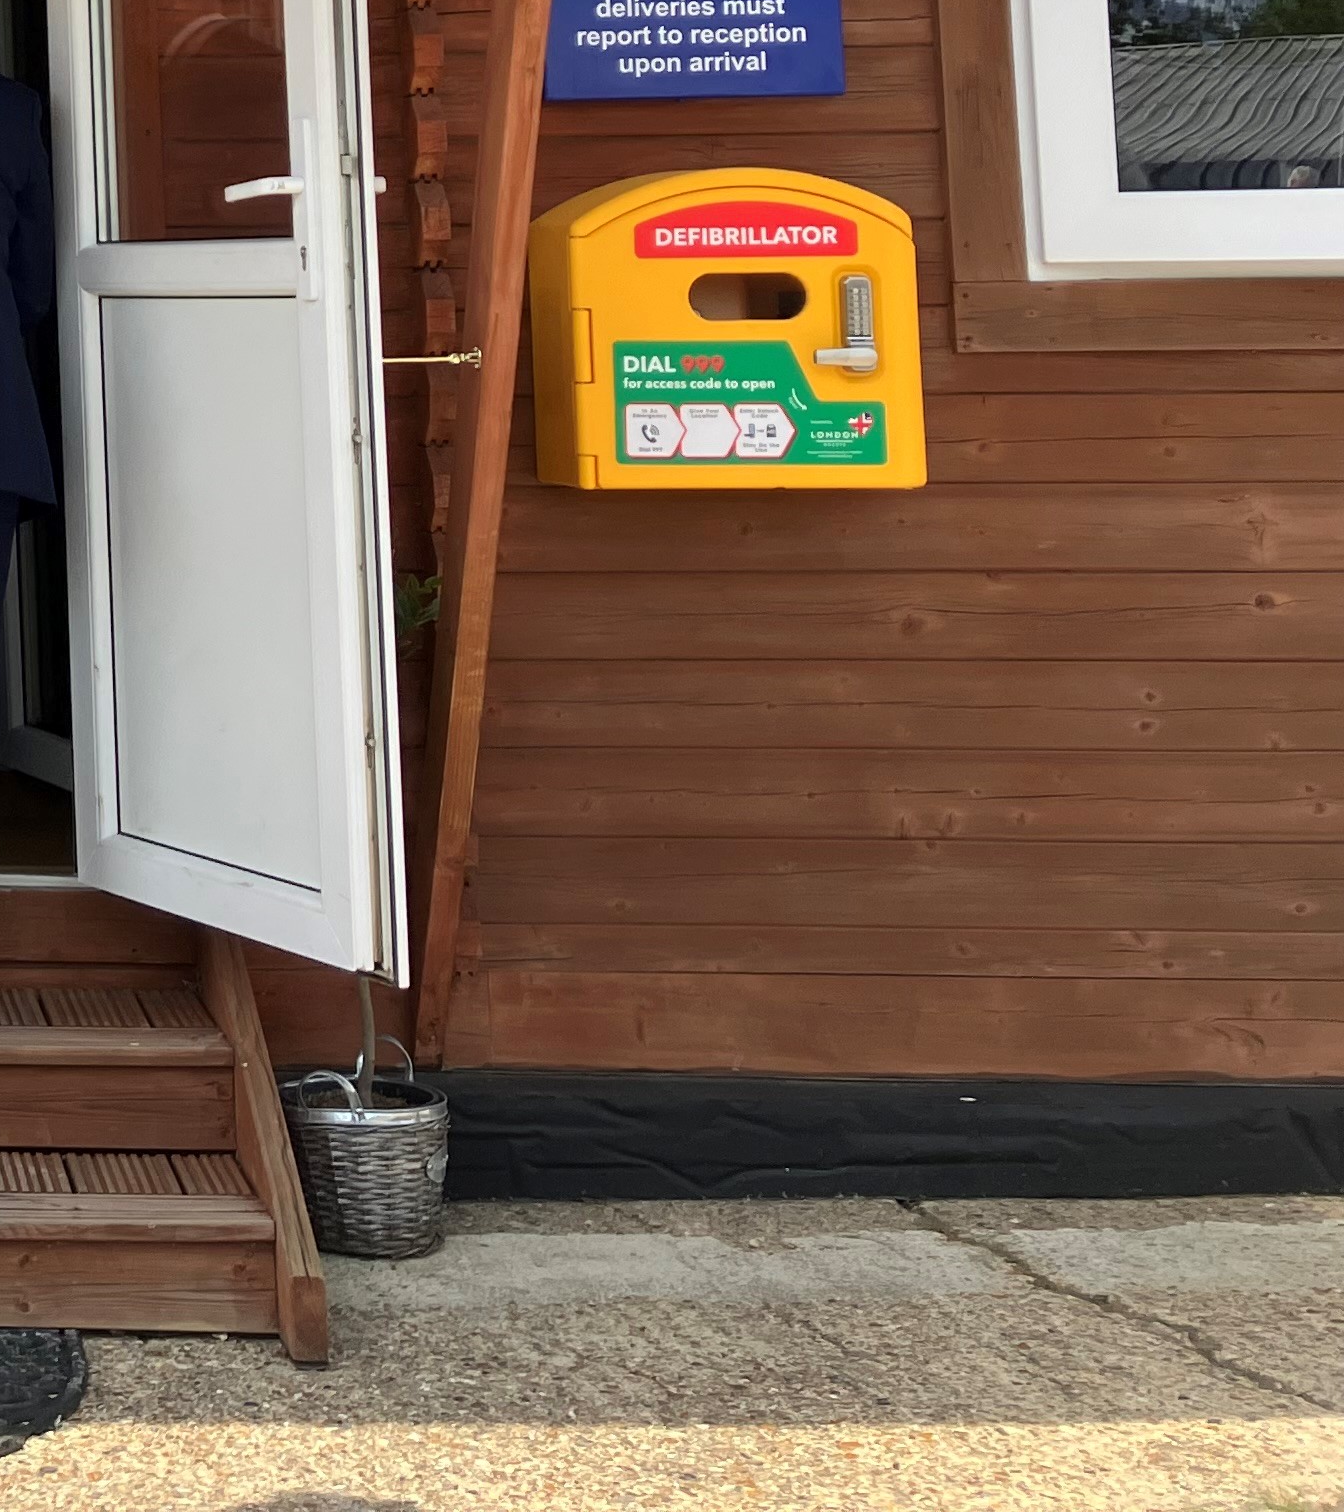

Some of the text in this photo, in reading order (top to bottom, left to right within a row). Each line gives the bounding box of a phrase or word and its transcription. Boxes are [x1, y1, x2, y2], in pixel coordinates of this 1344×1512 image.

[576, 22, 808, 51] report to reception
[618, 51, 768, 78] upon arrival
[654, 225, 839, 247] DEFIBRILLATOR
[623, 355, 677, 373] DIAL
[623, 376, 776, 392] for access code to open
[810, 431, 859, 439] LONDON
